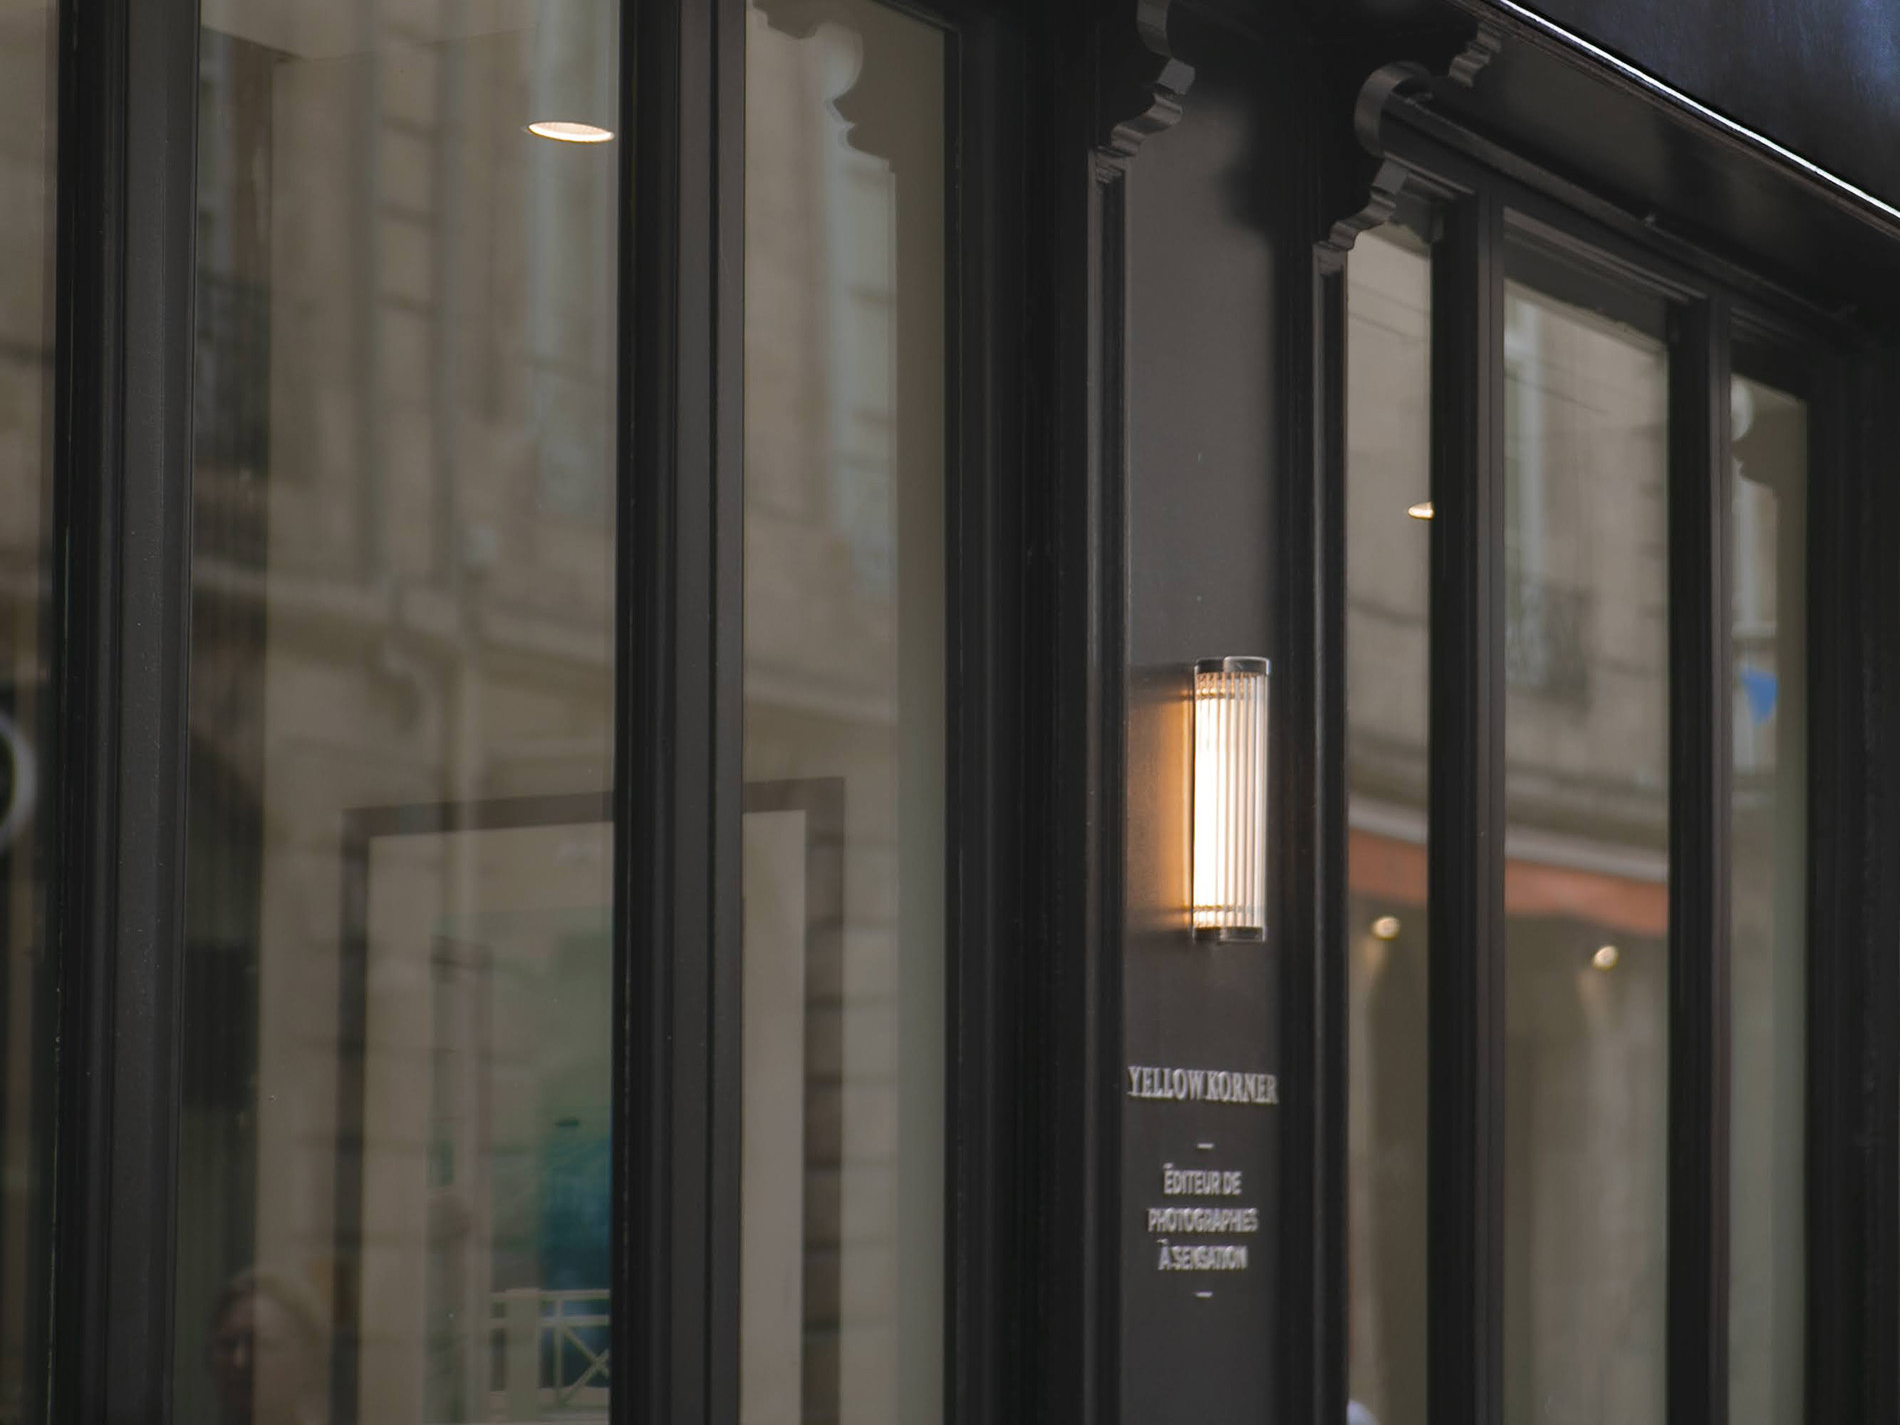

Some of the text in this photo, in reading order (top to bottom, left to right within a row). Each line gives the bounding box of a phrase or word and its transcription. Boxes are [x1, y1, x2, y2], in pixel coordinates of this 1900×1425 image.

[1127, 1065, 1279, 1105] YELLOW KORNER
[1163, 1162, 1243, 1195] ÉDITEUR DE
[1147, 1207, 1259, 1233] PHOTOGRAPHIES
[1172, 1245, 1248, 1270] SENSATION
